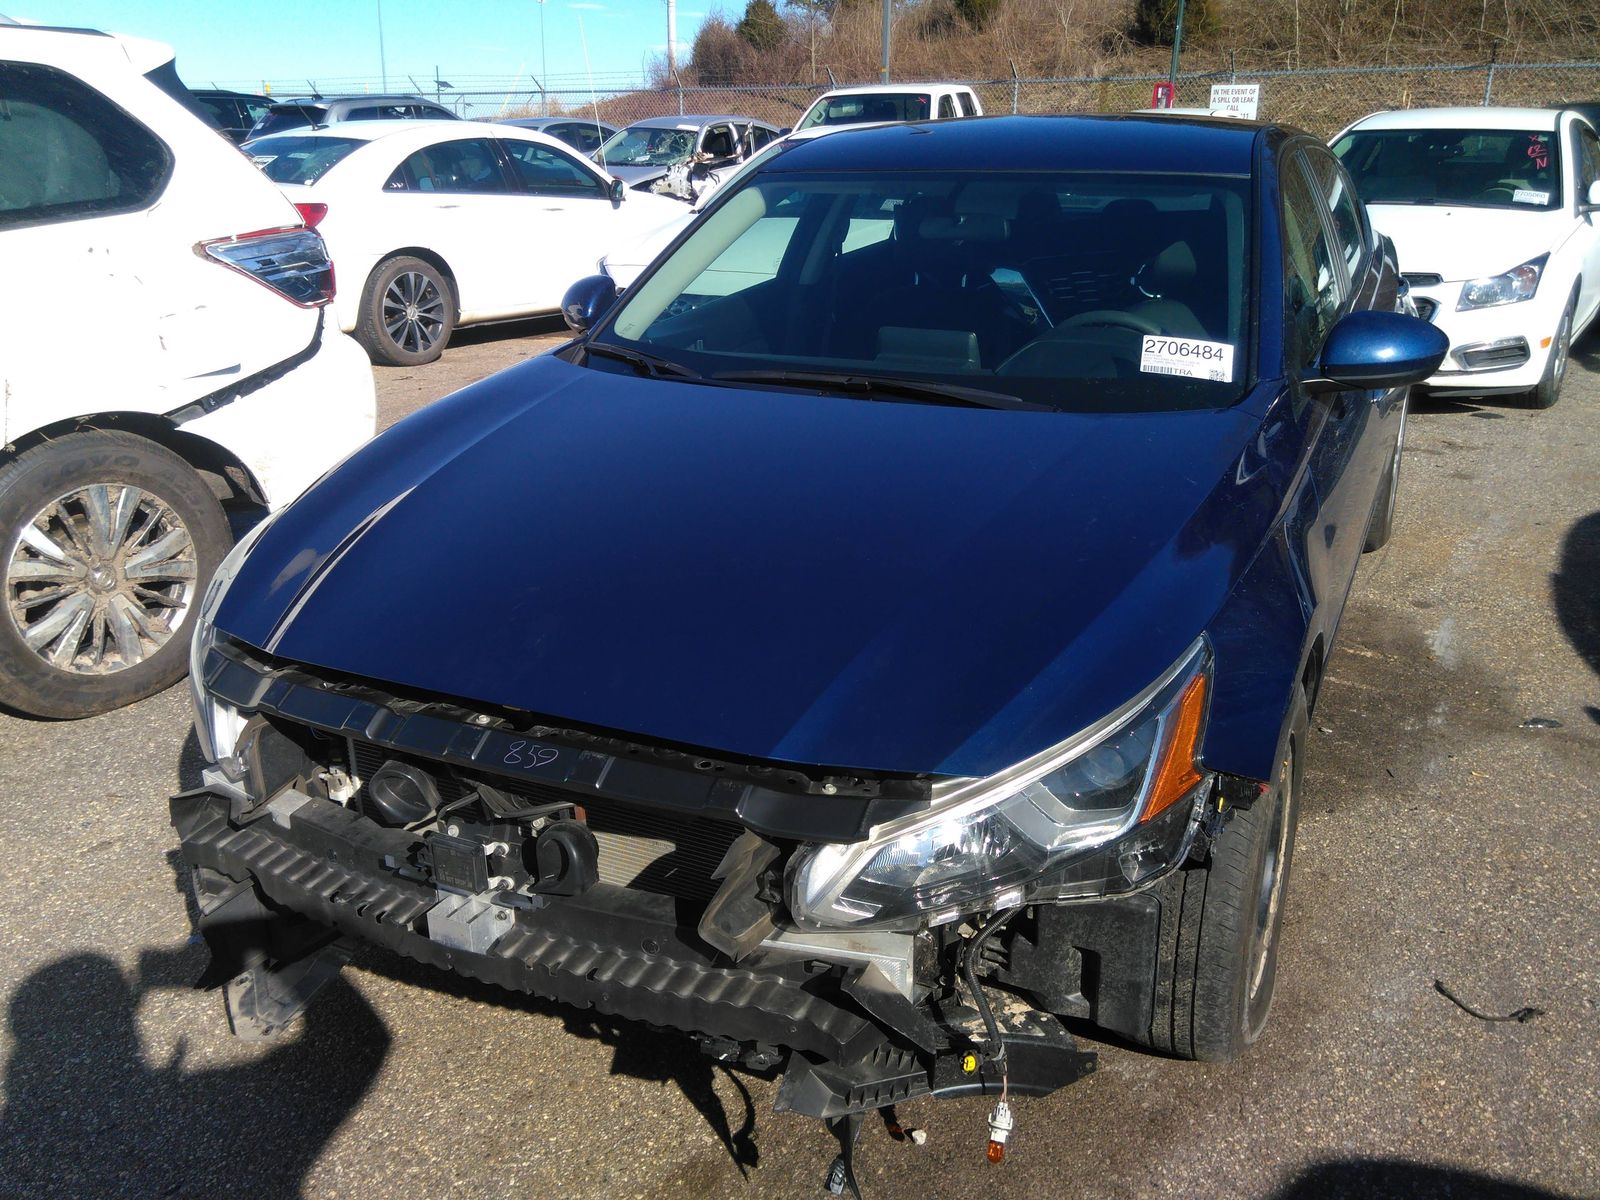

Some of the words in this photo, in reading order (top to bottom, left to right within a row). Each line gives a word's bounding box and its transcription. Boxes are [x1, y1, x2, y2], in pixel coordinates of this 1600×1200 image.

[1144, 339, 1224, 362] 2706484
[1174, 367, 1193, 377] TRA
[503, 740, 559, 769] 859
